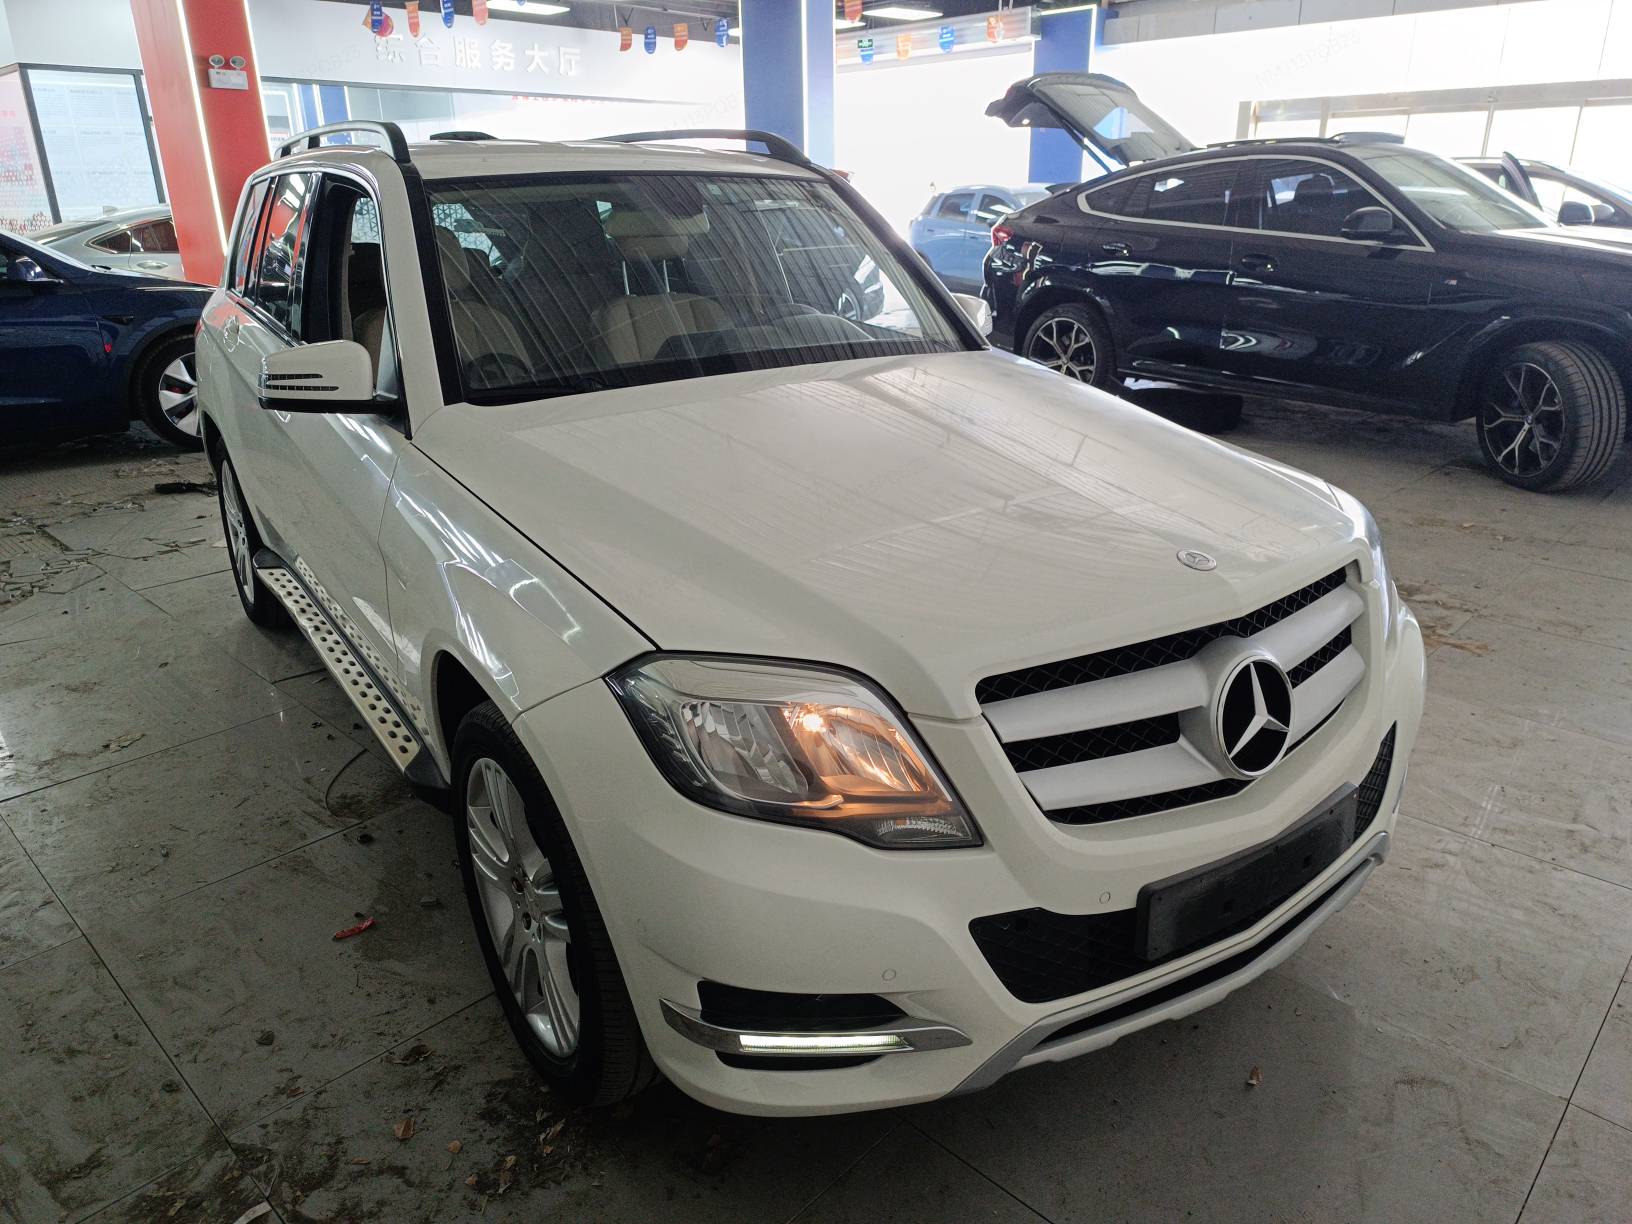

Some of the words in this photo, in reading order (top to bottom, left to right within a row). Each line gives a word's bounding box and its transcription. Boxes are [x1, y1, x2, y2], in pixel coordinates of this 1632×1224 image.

[374, 33, 582, 76] 综合服务大厅
